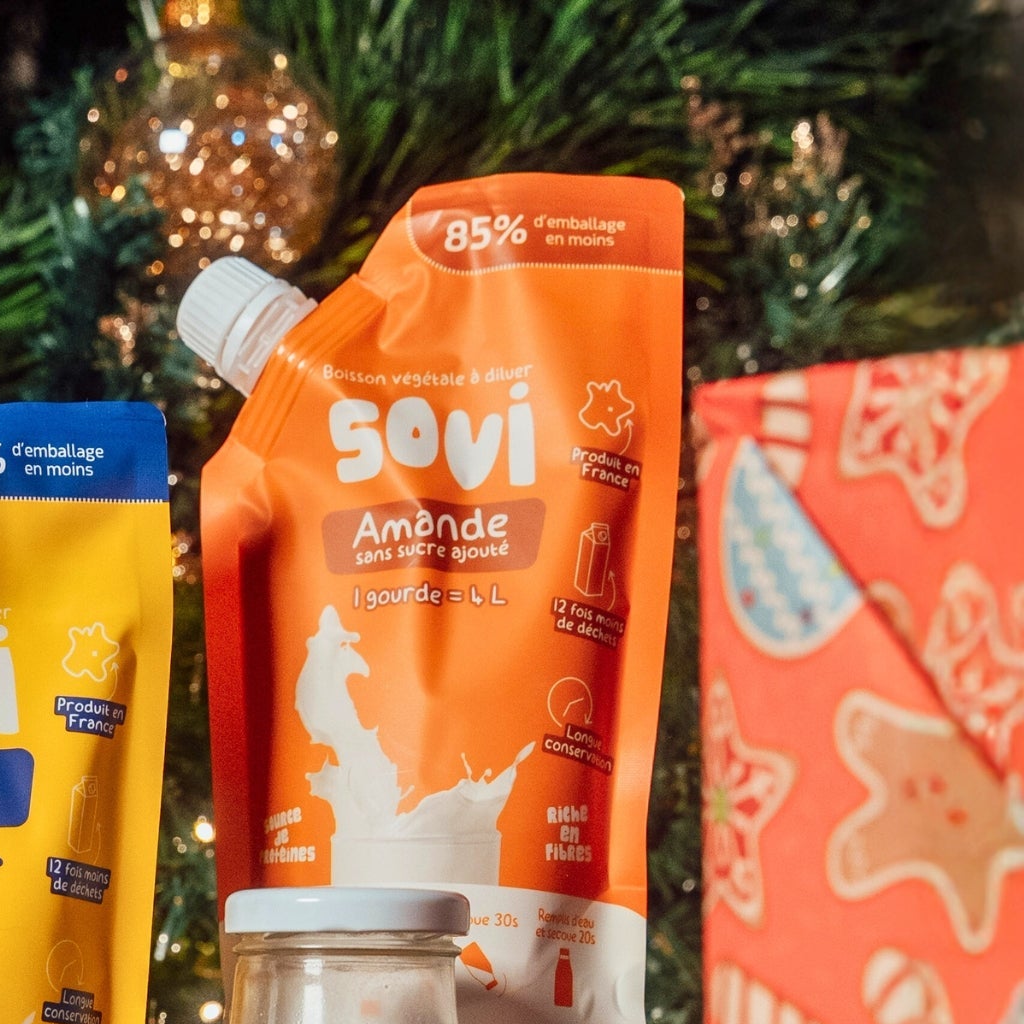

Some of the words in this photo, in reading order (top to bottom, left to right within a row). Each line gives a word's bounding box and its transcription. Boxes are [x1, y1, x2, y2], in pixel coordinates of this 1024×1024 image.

[444, 214, 527, 252] 85%
[545, 233, 564, 245] en
[568, 233, 615, 247] moins
[323, 364, 386, 385] Boisson
[392, 371, 465, 388] végétale
[470, 367, 480, 384] à
[485, 364, 533, 383] diluer
[11, 442, 104, 462] d'emballage
[572, 447, 621, 470] Produit
[625, 463, 640, 476] en
[25, 464, 42, 476] en
[47, 462, 94, 477] moins
[582, 464, 629, 488] France
[352, 508, 509, 549] Amande
[356, 547, 392, 565] sans
[397, 542, 446, 558] sucre
[451, 539, 509, 563] ajouté
[366, 583, 442, 610] gourde
[471, 585, 484, 606] 4
[491, 584, 507, 604] L
[553, 598, 566, 614] 12
[571, 603, 593, 621] fois
[596, 615, 624, 633] moins
[556, 617, 574, 631] de
[577, 621, 617, 647] déchets
[57, 697, 110, 717] Produit
[112, 709, 124, 721] en
[68, 713, 115, 734] France
[566, 725, 603, 751] Longue
[544, 739, 612, 772] conservation
[560, 825, 580, 844] en
[49, 858, 62, 874] 12
[65, 862, 83, 879] fois
[84, 869, 109, 885] moins
[53, 877, 69, 892] de
[70, 881, 103, 901] déchets
[494, 913, 519, 928] 30s
[536, 927, 546, 939] et
[547, 928, 577, 943] secoue
[579, 930, 596, 945] 20s
[63, 990, 94, 1009] Longue
